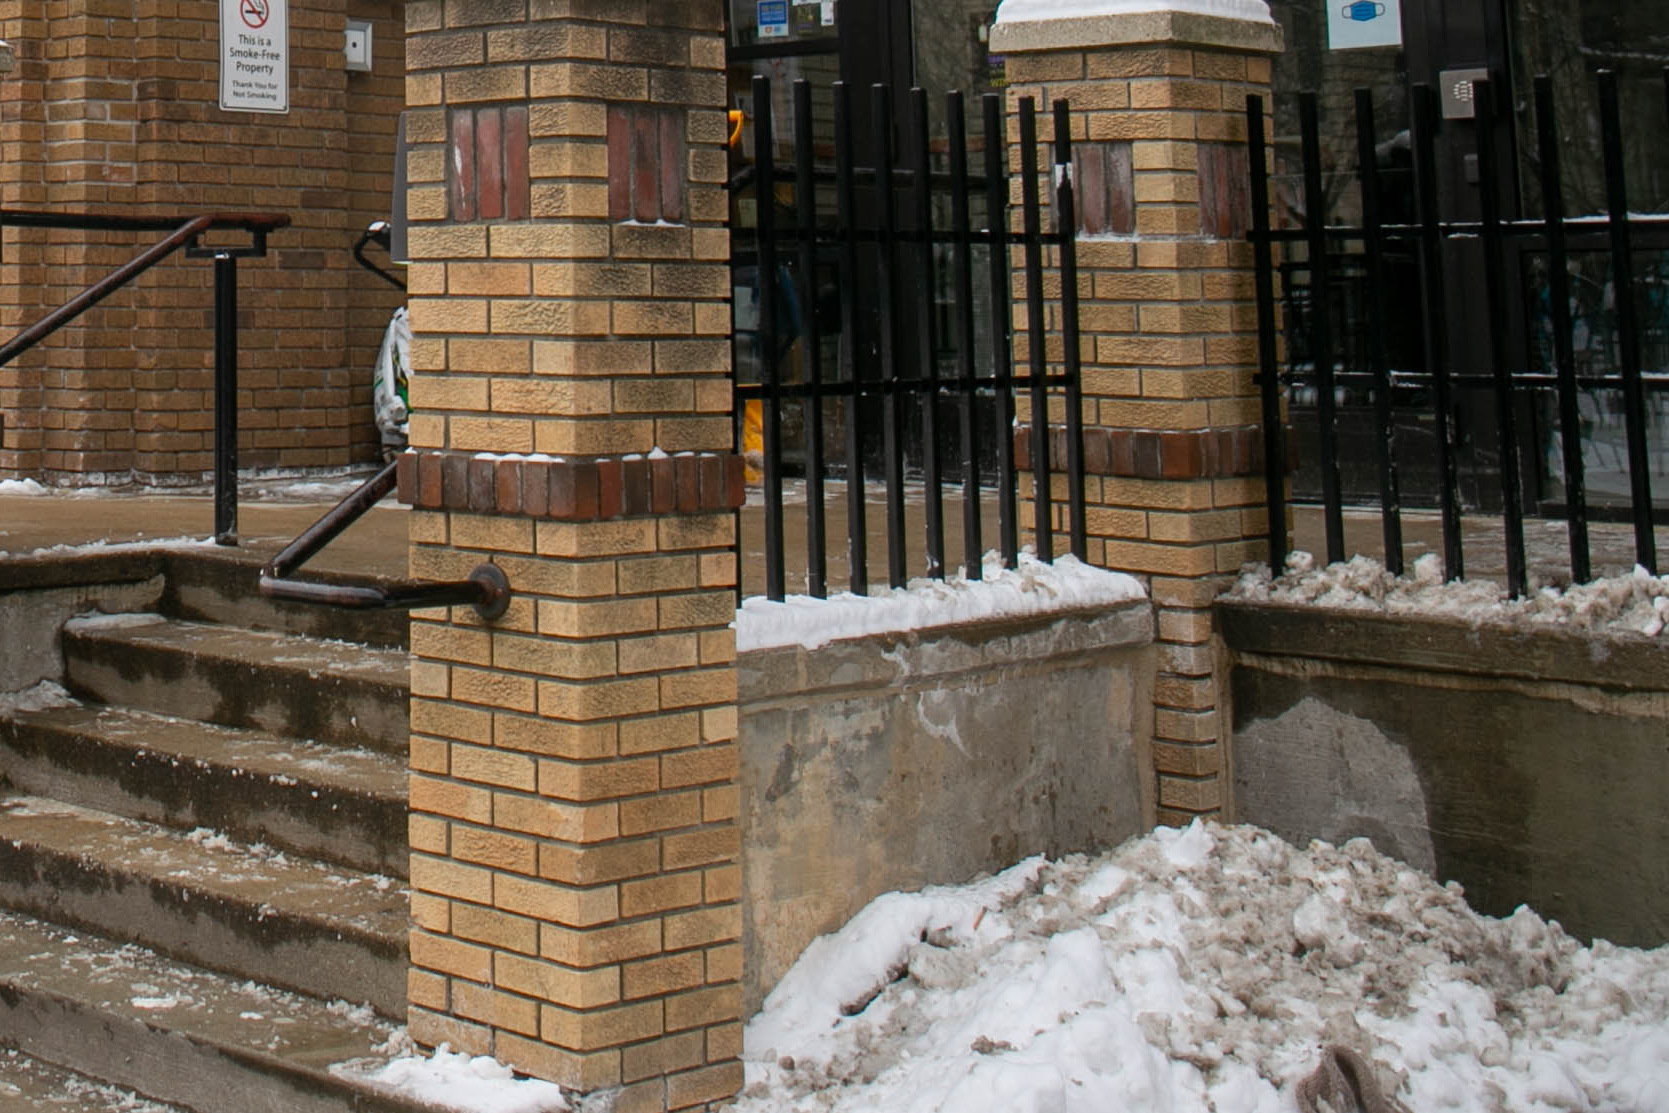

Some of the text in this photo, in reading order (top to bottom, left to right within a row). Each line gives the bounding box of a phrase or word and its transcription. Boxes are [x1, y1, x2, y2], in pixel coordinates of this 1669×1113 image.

[238, 34, 255, 46] This
[257, 35, 265, 46] is
[229, 47, 281, 61] Smoke-Free
[236, 61, 274, 76] Property
[232, 79, 278, 90] Thank You for
[247, 91, 277, 101] Smoking
